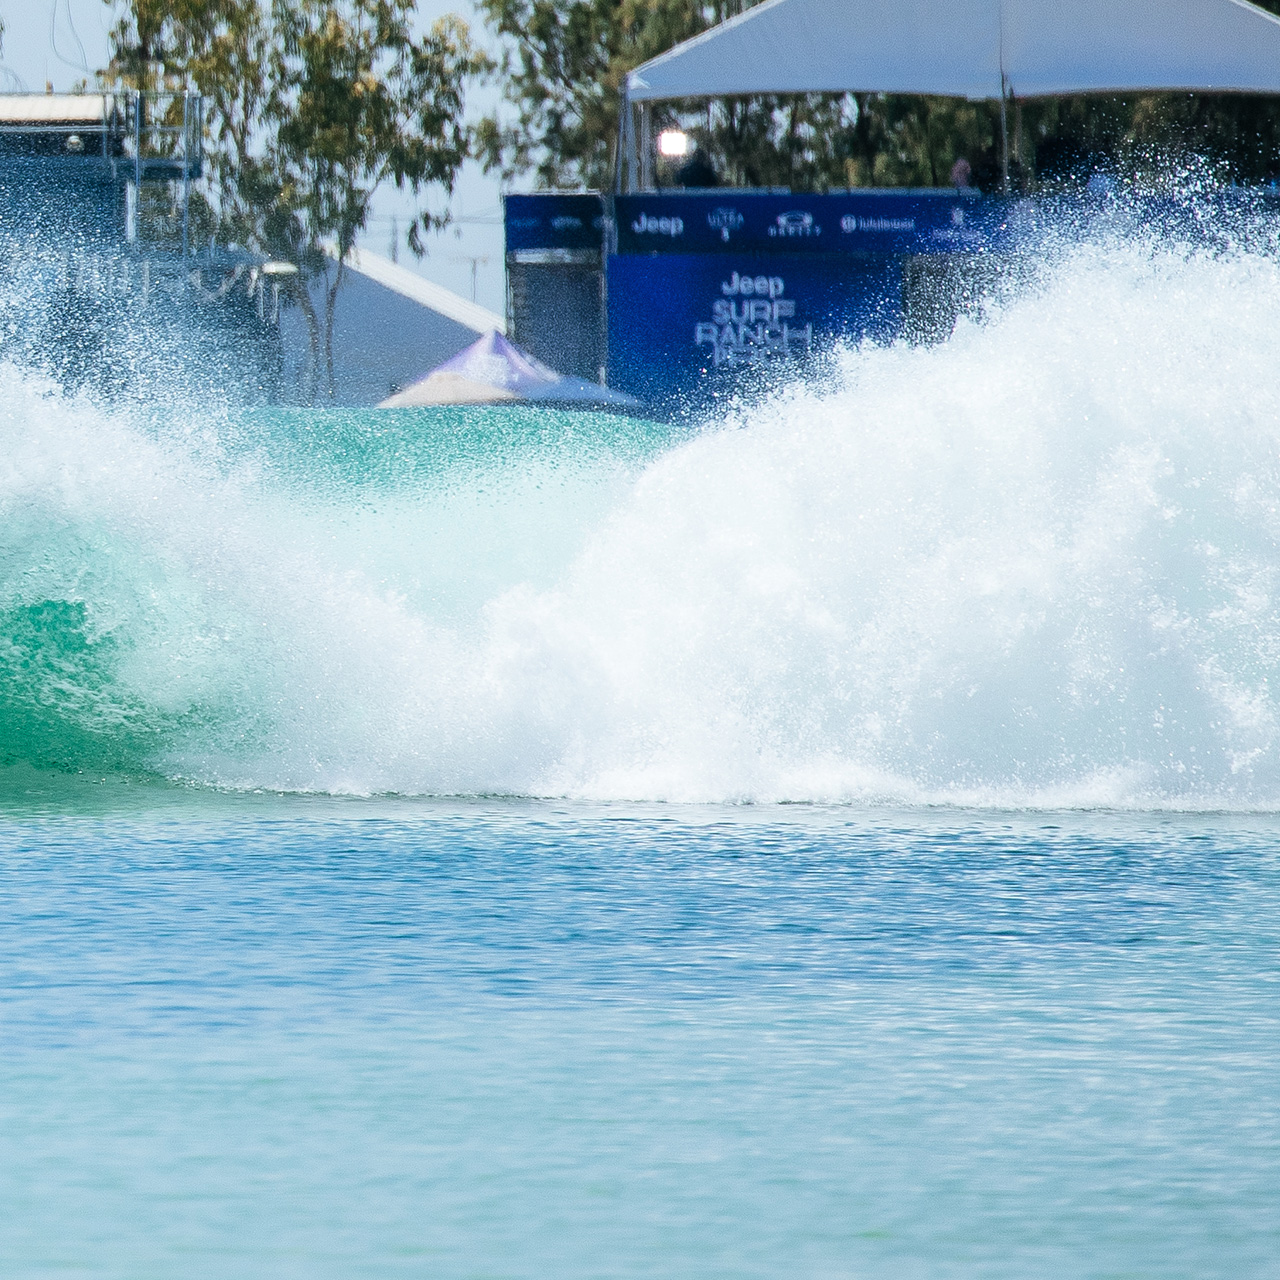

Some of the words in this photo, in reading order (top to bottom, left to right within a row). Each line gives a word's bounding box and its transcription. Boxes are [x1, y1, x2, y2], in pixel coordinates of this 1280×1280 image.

[631, 212, 684, 237] Jeep
[721, 271, 785, 299] Jeep
[712, 299, 796, 324] SURF
[695, 322, 813, 347] RANCH
